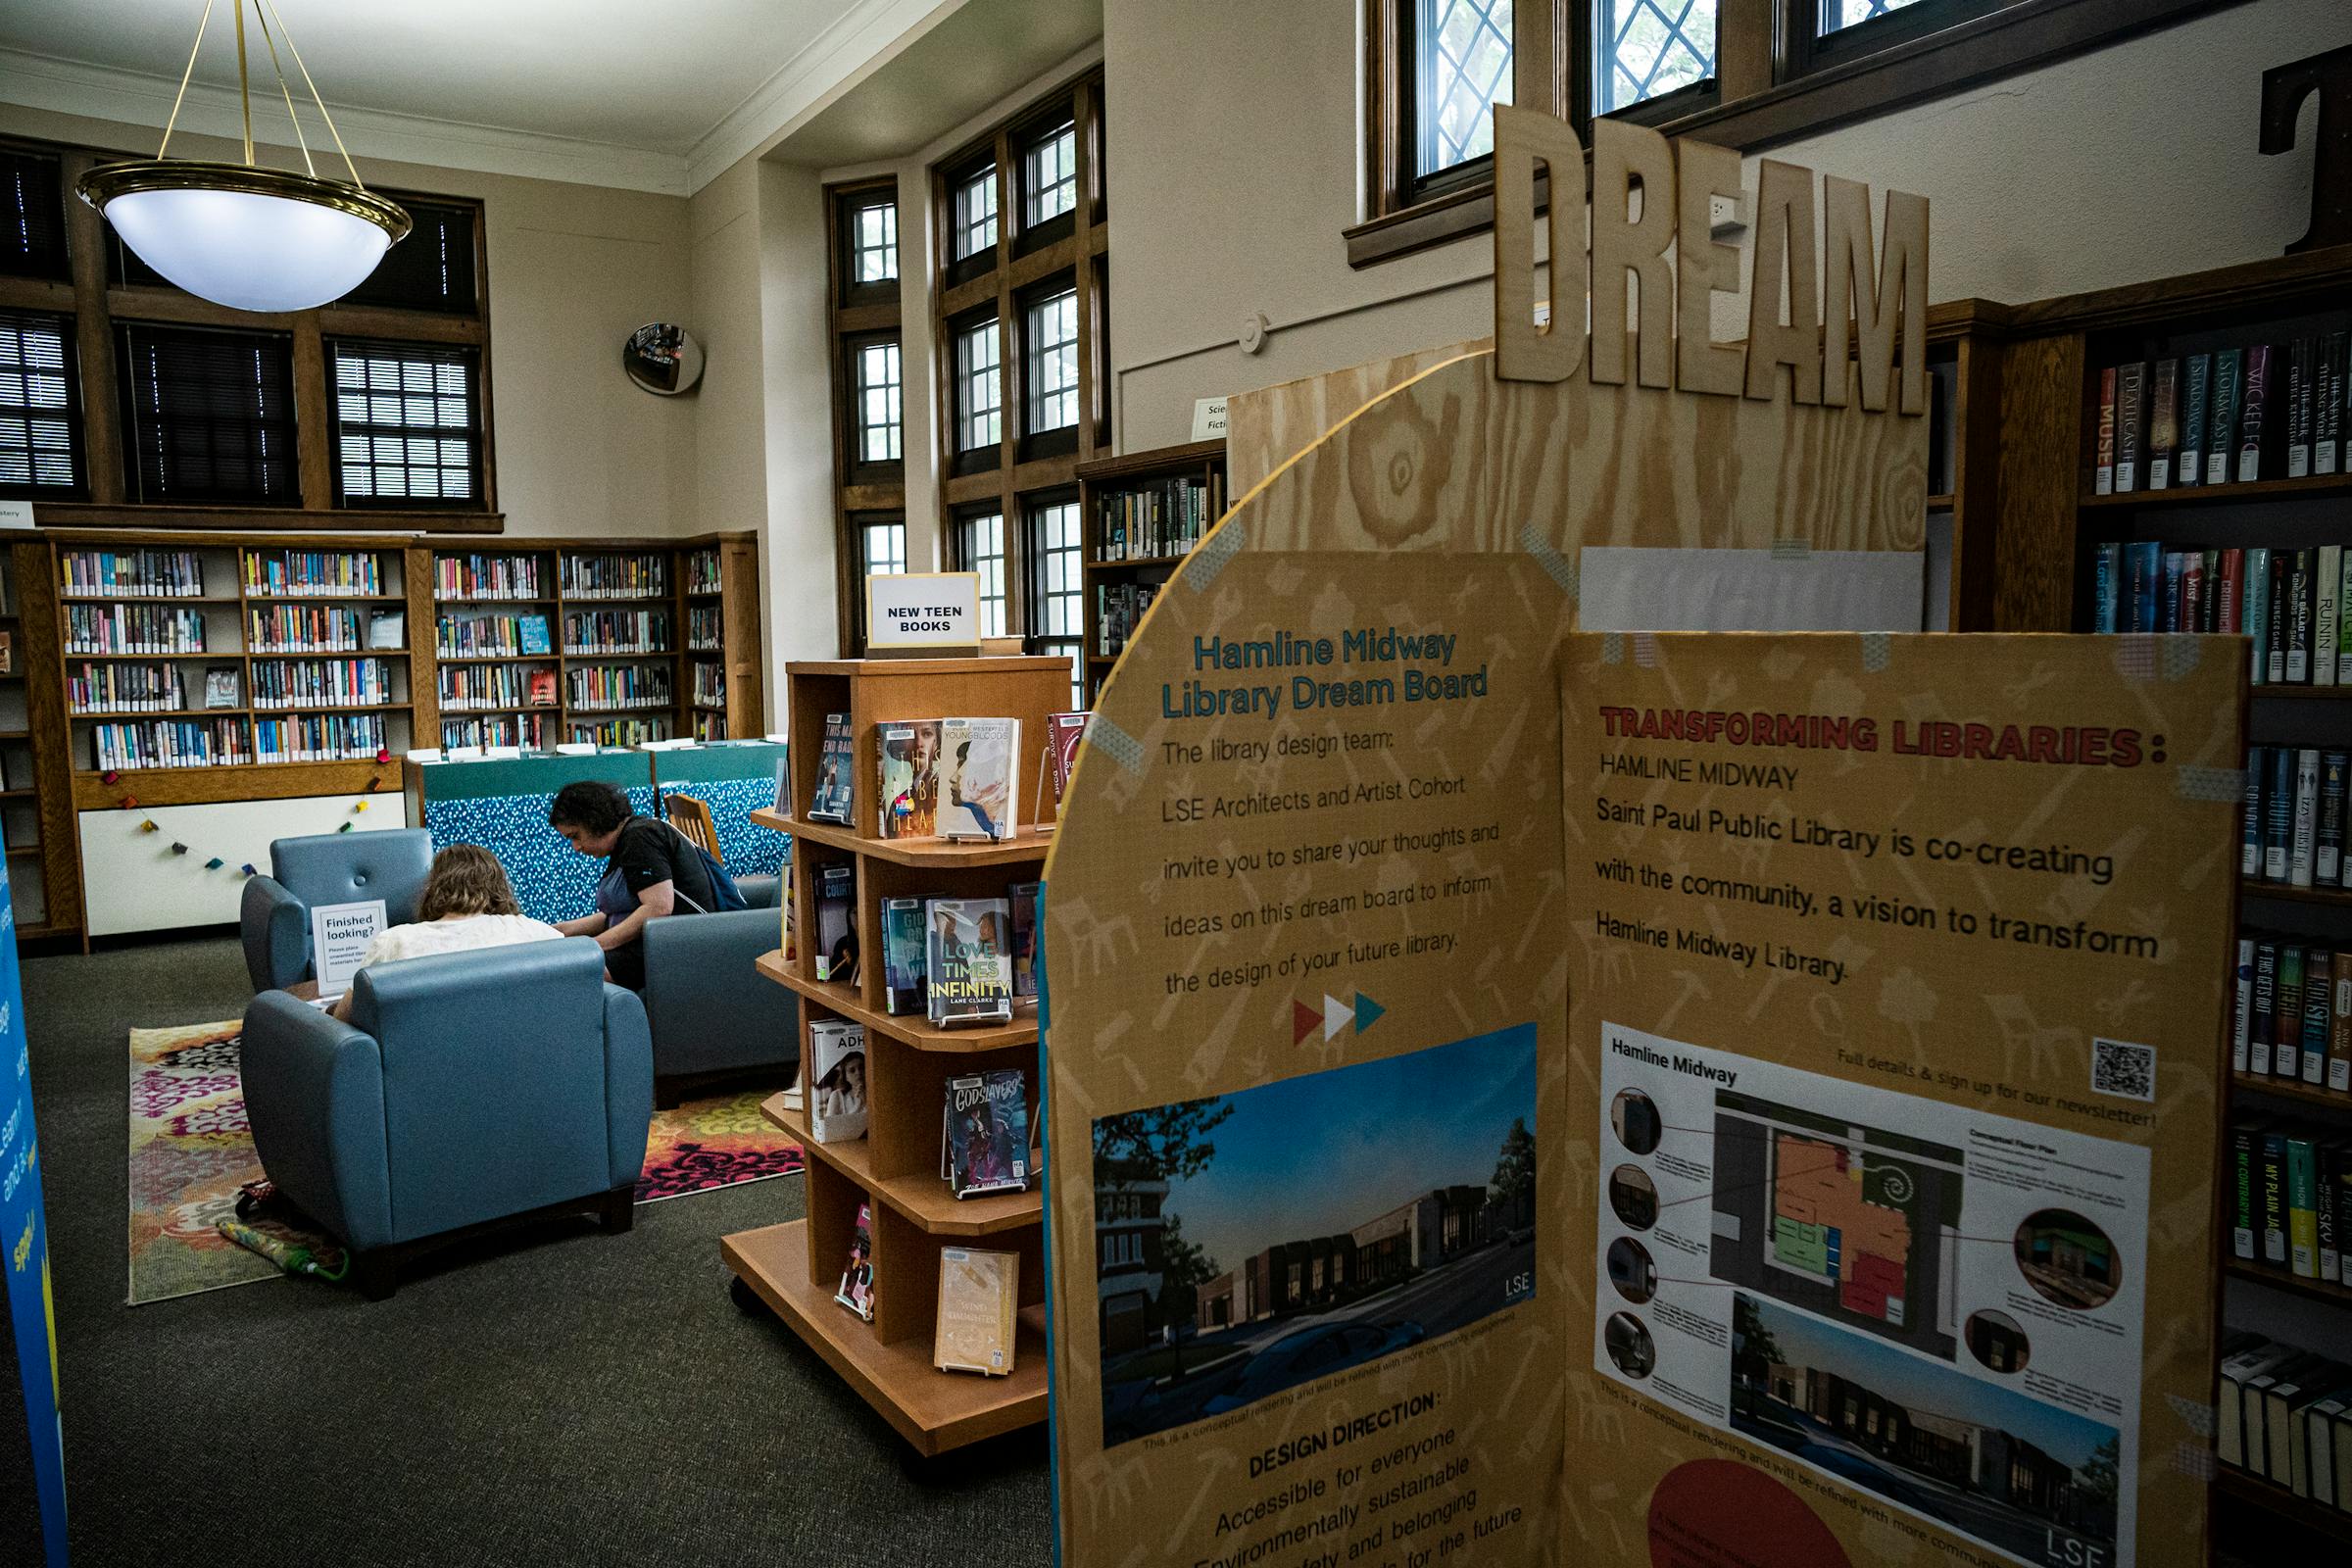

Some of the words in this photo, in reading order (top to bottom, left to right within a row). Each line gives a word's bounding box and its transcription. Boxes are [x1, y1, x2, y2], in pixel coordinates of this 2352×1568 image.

[1493, 103, 1930, 416] DREAM
[1208, 405, 1226, 414] Scie
[1208, 420, 1227, 429] Ficti
[2123, 374, 2139, 463] DEATHCASTE
[2288, 404, 2298, 446] KINGDO
[2317, 411, 2328, 441] WORL
[2097, 404, 2114, 466] MUSE
[888, 607, 920, 617] NEW
[924, 607, 962, 617] TEEN
[901, 621, 951, 632] BOOKS
[2319, 599, 2332, 650] RUININ
[1194, 630, 1334, 670] Hamline
[1343, 627, 1456, 665] Midway
[1162, 680, 1282, 721] Library
[1293, 676, 1395, 710] Dream
[1405, 665, 1488, 702] Board
[945, 732, 1008, 741] YOUNGBLOODS
[1162, 741, 1202, 764] The
[1211, 737, 1270, 763] library
[1277, 733, 1338, 760] design
[1344, 731, 1394, 751] team:
[1599, 707, 1879, 753] TRANSFORMING
[1893, 720, 2167, 767] LIBRARIES:
[1600, 754, 1693, 782] HAMLINE
[1699, 760, 1799, 792] MIDWAY
[1162, 799, 1203, 822] LSE
[1212, 791, 1309, 819] Architects
[1317, 787, 1349, 808] and
[1354, 781, 1402, 806] Artist
[1408, 776, 1465, 799] Cohort
[1163, 856, 1218, 880] invite
[1226, 855, 1260, 875] you
[1266, 848, 1286, 867] to
[1293, 840, 1342, 864] share
[1348, 839, 1387, 860] your
[1394, 826, 1465, 855] thoughts
[1471, 821, 1499, 843] and
[1596, 797, 1645, 827] Saint
[1653, 803, 1701, 833] Paul
[1709, 809, 1783, 842] Public
[1791, 819, 1881, 858] Library
[1891, 828, 1915, 858] is
[1926, 837, 2115, 885] co-creating
[326, 914, 372, 928] Finished
[1164, 911, 1222, 938] ideas
[1231, 911, 1254, 930] on
[1261, 902, 1293, 924] this
[1300, 893, 1355, 919] dream
[1363, 884, 1414, 909] board
[1420, 880, 1437, 901] to
[1443, 874, 1492, 899] inform
[1595, 858, 1635, 884] with
[1641, 863, 1673, 892] the
[1681, 871, 1820, 917] community,
[1828, 897, 1843, 918] a
[1853, 892, 1936, 930] vision
[1948, 905, 1978, 937] to
[1988, 910, 2159, 958] transform
[327, 927, 374, 940] looking?
[945, 942, 996, 959] LOVE
[1596, 910, 1668, 949] Hamline
[1676, 927, 1757, 969] Midway
[1765, 944, 1849, 985] Library.
[942, 961, 1000, 978] TIMES
[1166, 972, 1200, 995] the
[1208, 961, 1271, 991] design
[1279, 956, 1296, 977] of
[1301, 953, 1341, 977] your
[1348, 940, 1399, 965] future
[1405, 929, 1458, 957] library.
[2257, 956, 2274, 973] THIS
[932, 981, 1011, 998] INFINITY
[2255, 998, 2271, 1014] OUT
[2256, 976, 2272, 995] GETS
[2305, 977, 2329, 1042] MONSTER
[1612, 1037, 1669, 1068] Hamline
[1673, 1054, 1739, 1088] Midway
[1866, 1054, 1916, 1079] details
[1936, 1067, 1969, 1093] sign
[1972, 1076, 1993, 1097] up
[1995, 1077, 2019, 1101] for
[2024, 1089, 2052, 1107] our
[956, 1078, 1018, 1111] GODSLAYERS
[2265, 1164, 2278, 1180] MY
[2266, 1182, 2279, 1212] PLAIN
[2319, 1213, 2332, 1243] SKY
[1505, 1271, 1530, 1297] LSE
[1143, 1437, 1166, 1451] This
[1193, 1408, 1250, 1438] conceptual
[1250, 1393, 1295, 1420] rendering
[1298, 1385, 1315, 1402] and
[1316, 1379, 1333, 1397] will
[1334, 1374, 1347, 1390] be
[1383, 1354, 1401, 1372] with
[1250, 1430, 1328, 1478] DESIGN
[1333, 1391, 1442, 1446] DIRECTION:
[1215, 1480, 1326, 1537] Accessible
[1337, 1462, 1361, 1489] for
[1371, 1427, 1456, 1477] everyone
[1599, 1380, 1619, 1398] This
[1692, 1427, 1746, 1464] rendering
[1746, 1447, 1772, 1472] and
[1773, 1457, 1796, 1483] will
[1798, 1472, 1813, 1490] be
[1815, 1477, 1859, 1510] refined
[1860, 1499, 1890, 1526] with
[1893, 1516, 1928, 1543] more
[1368, 1454, 1470, 1514] sustainable
[1348, 1529, 1383, 1560] and
[1392, 1489, 1478, 1541] belonging
[1440, 1531, 1465, 1556] the
[1473, 1504, 1523, 1539] future
